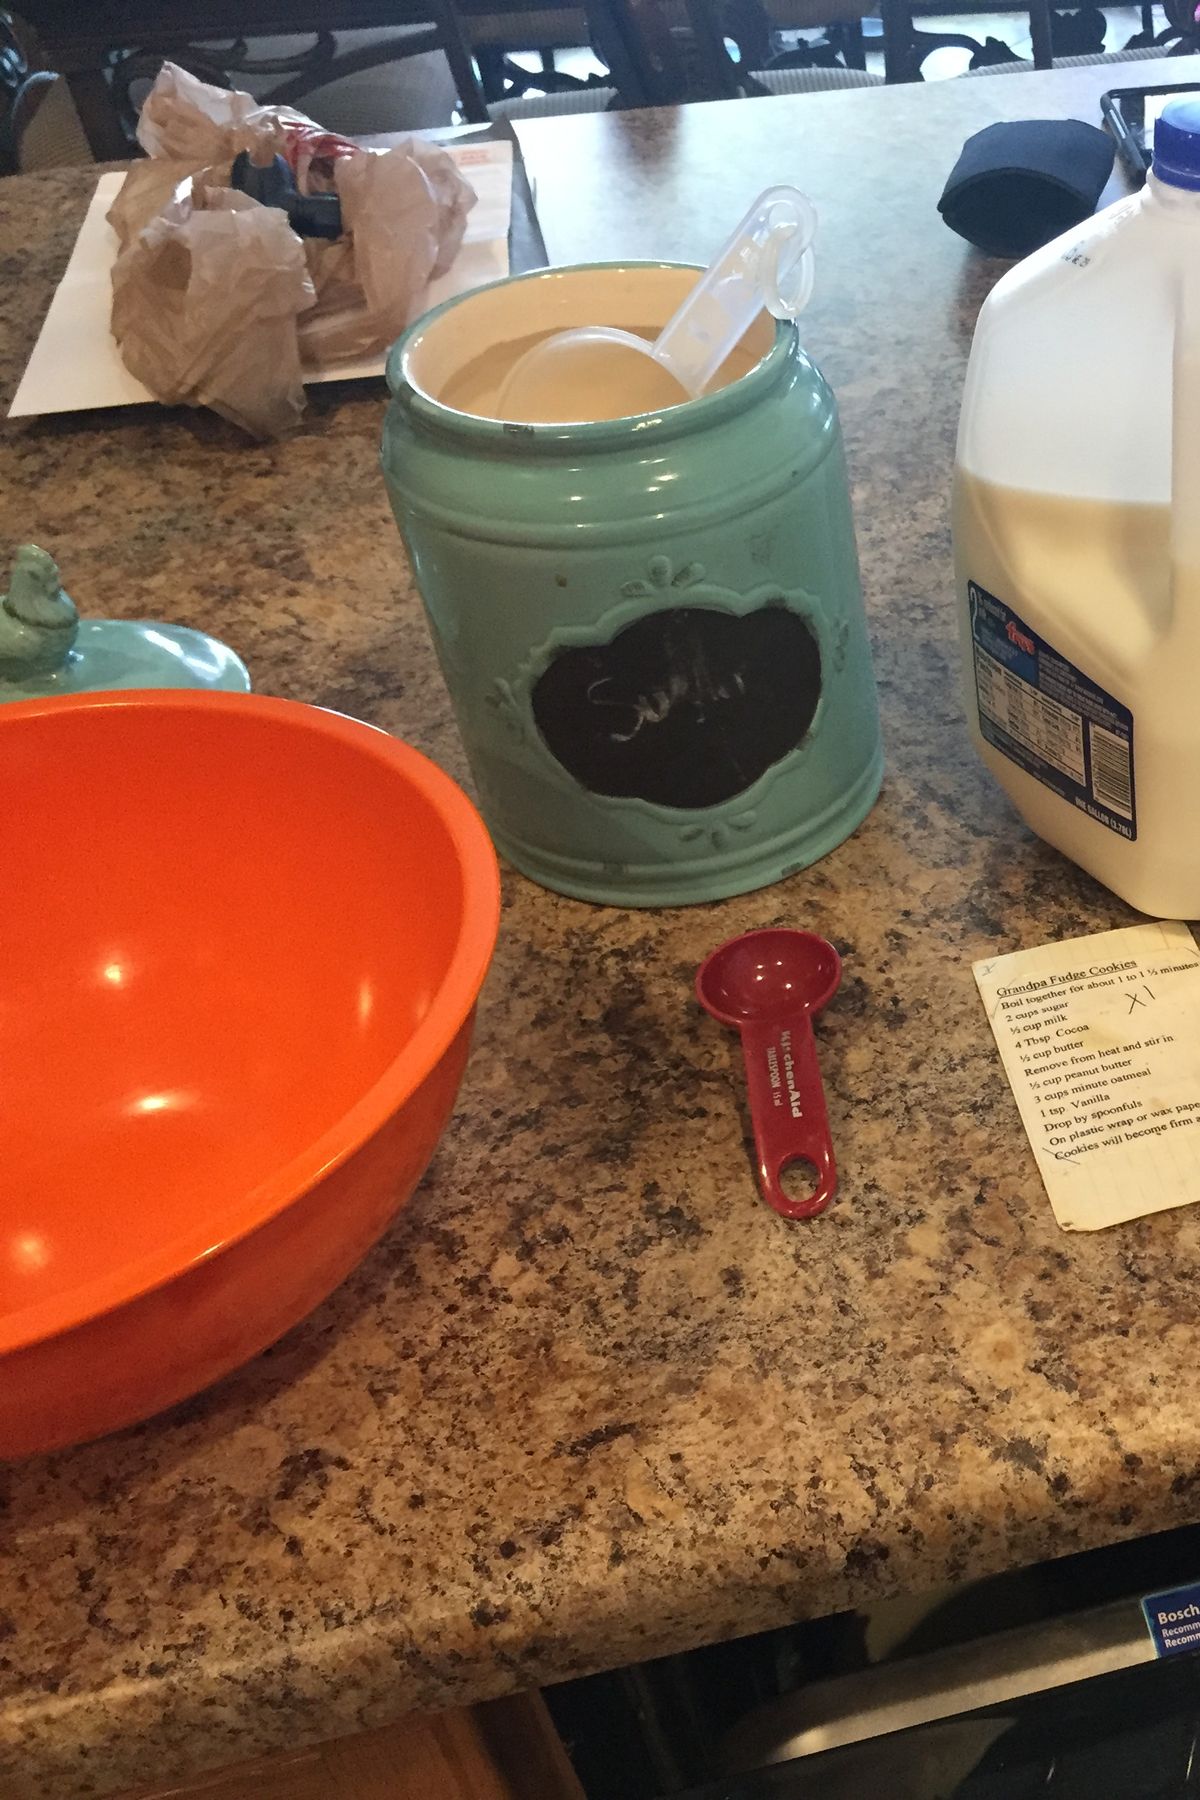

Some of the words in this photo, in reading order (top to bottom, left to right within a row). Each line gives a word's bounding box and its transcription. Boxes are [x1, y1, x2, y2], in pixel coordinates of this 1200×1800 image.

[996, 980, 1048, 998] Grandpa
[1050, 970, 1087, 986] Fudge
[1089, 960, 1137, 976] Cookies
[1001, 998, 1023, 1010] Boil
[1026, 989, 1067, 1004] together
[1070, 983, 1084, 993] for
[1088, 978, 1115, 990] about
[1126, 973, 1137, 982] to
[1160, 961, 1199, 974] minutes
[1015, 1009, 1039, 1022] cups
[1041, 1002, 1069, 1014] sugar
[1022, 1022, 1042, 1033] cup
[1044, 1014, 1069, 1026] milk
[1015, 1041, 1022, 1049] 4
[1024, 1035, 1051, 1047] Tbsp
[1056, 1024, 1090, 1038] Cocoa
[1032, 1050, 1051, 1060] cup
[1053, 1040, 1085, 1054] butter
[1024, 1059, 1069, 1077] Remove
[1070, 1053, 1096, 1065] from
[1097, 1046, 1121, 1058] heat
[1122, 1041, 1142, 1052] and
[1144, 1037, 1161, 1048] stir
[1162, 1034, 1174, 1043] in
[1034, 1095, 1041, 1104] 3
[1044, 1088, 1069, 1101] cups
[1071, 1079, 1108, 1094] minute
[1110, 1068, 1152, 1084] oatmeal
[1042, 1076, 1062, 1087] cup
[1064, 1067, 1100, 1081] peanut
[1101, 1058, 1132, 1072] butter
[1040, 1109, 1046, 1117] 1
[1049, 1106, 1066, 1117] tsp
[1070, 1093, 1110, 1109] Vanilla
[1043, 1119, 1073, 1132] Drop
[1073, 1115, 1088, 1124] by
[1091, 1100, 1143, 1119] spoonfuls
[1049, 1136, 1066, 1146] On
[1069, 1124, 1105, 1142] plastic
[1107, 1118, 1134, 1130] wrap
[1136, 1113, 1148, 1122] or
[1150, 1107, 1173, 1118] wax
[1055, 1141, 1100, 1160] Cookies
[1101, 1135, 1123, 1147] will
[1124, 1123, 1168, 1141] become
[1169, 1118, 1193, 1129] firm
[1157, 1604, 1200, 1625] Bosch
